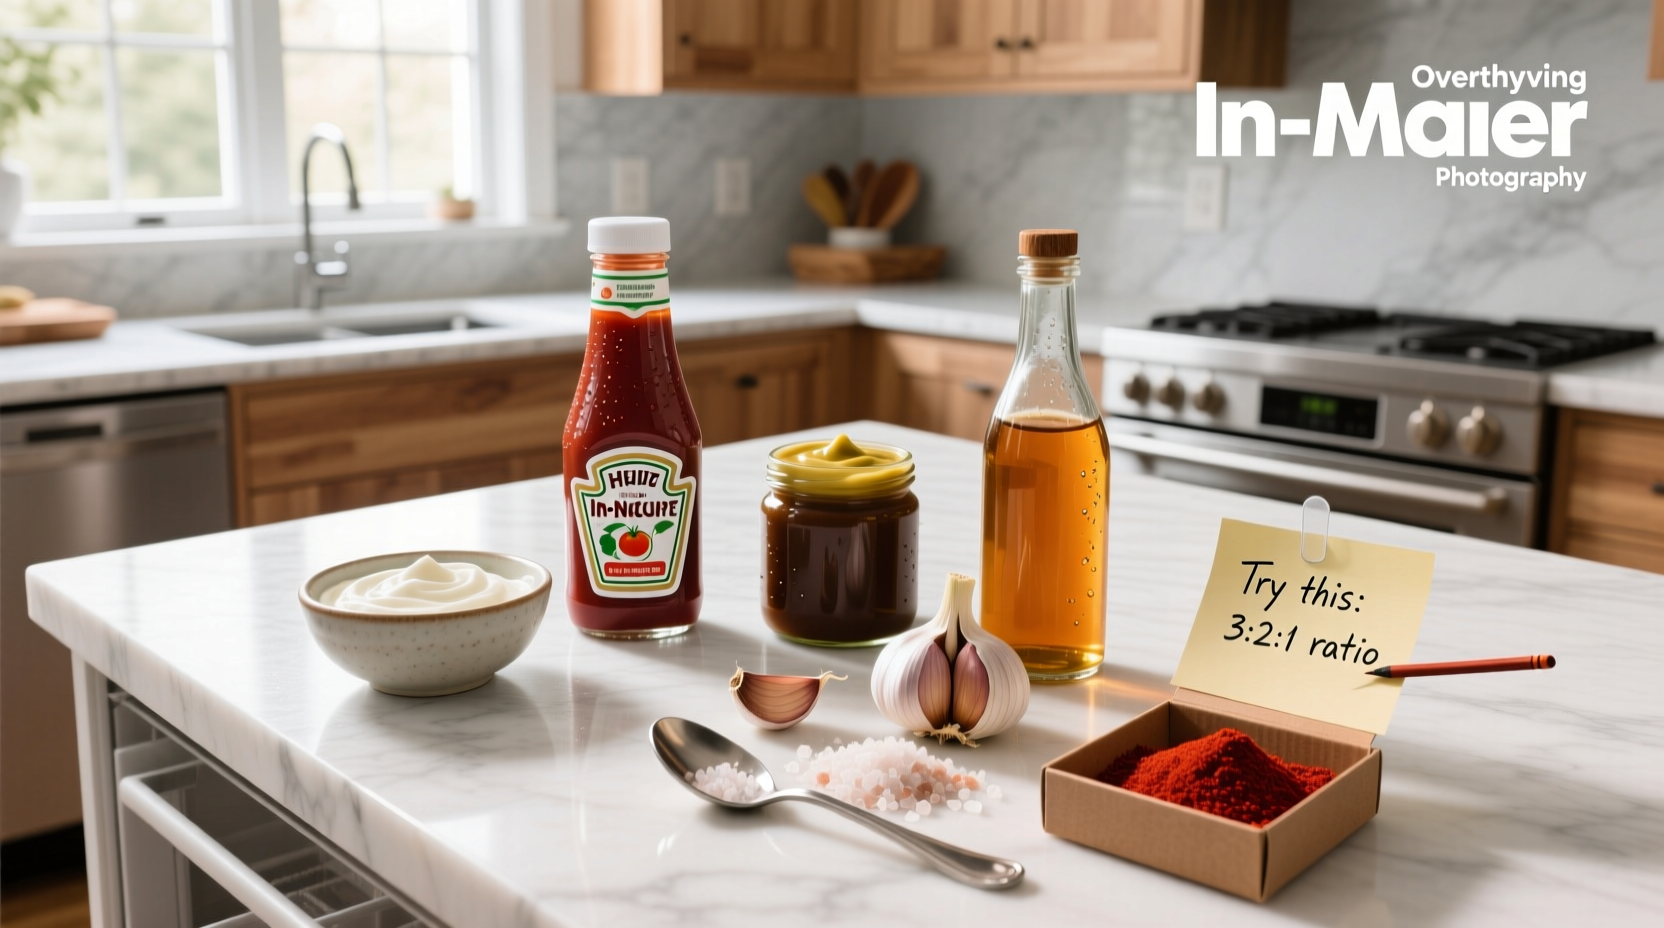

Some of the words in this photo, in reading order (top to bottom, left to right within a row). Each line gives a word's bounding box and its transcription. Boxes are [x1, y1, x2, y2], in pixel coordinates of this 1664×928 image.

[1241, 560, 1287, 612] Try
[1300, 575, 1365, 613] this:
[1223, 613, 1298, 652] 3:2:1
[1309, 632, 1379, 666] ratio
